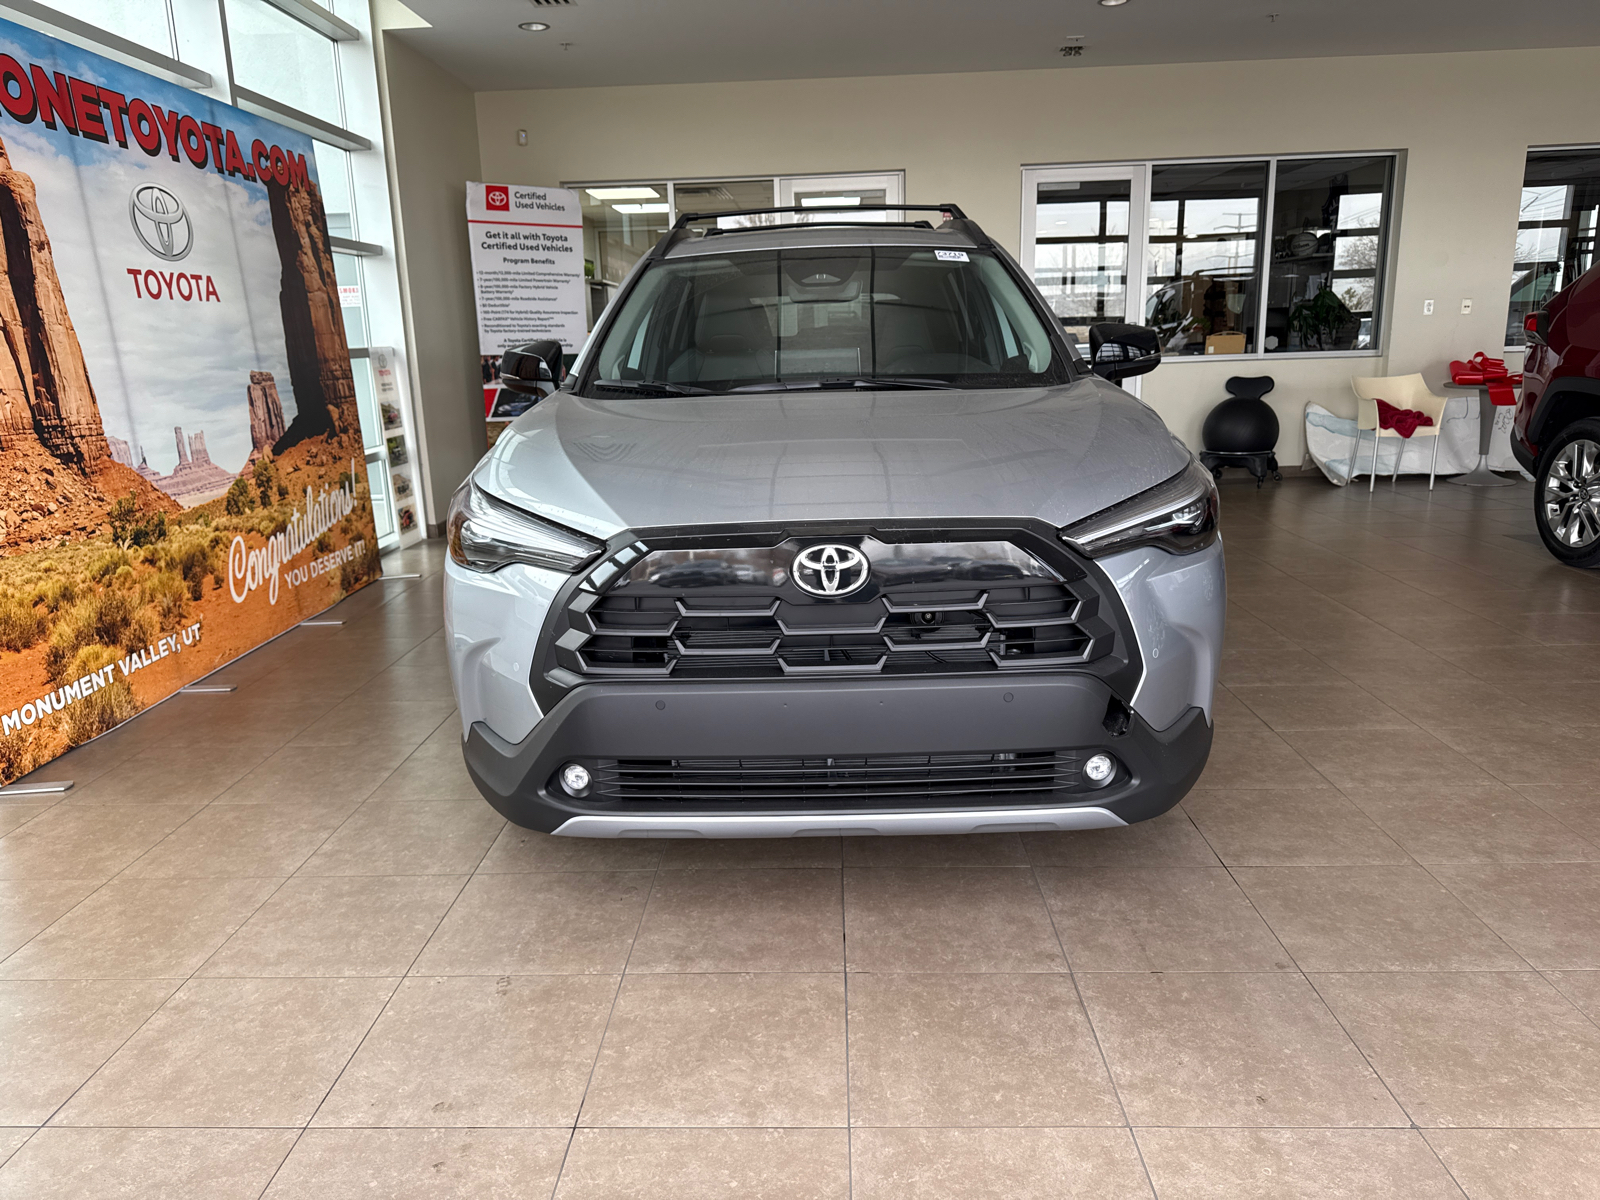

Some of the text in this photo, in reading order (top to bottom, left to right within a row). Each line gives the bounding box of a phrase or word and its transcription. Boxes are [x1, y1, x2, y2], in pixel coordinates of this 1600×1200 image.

[0, 53, 311, 192] ONETOYOTA.COM
[514, 191, 547, 200] Certified
[515, 201, 565, 211] Used Vehicles
[481, 242, 518, 250] Certified
[519, 243, 540, 251] Used
[485, 231, 568, 243] Get it all with Toyota
[503, 257, 555, 265] Program Benefits
[127, 268, 221, 302] TOYOTA
[229, 457, 358, 606] Congratulations!
[284, 539, 367, 589] YOU DESERVE IT!
[1, 622, 201, 736] MONUMENT VALLEY, UT
